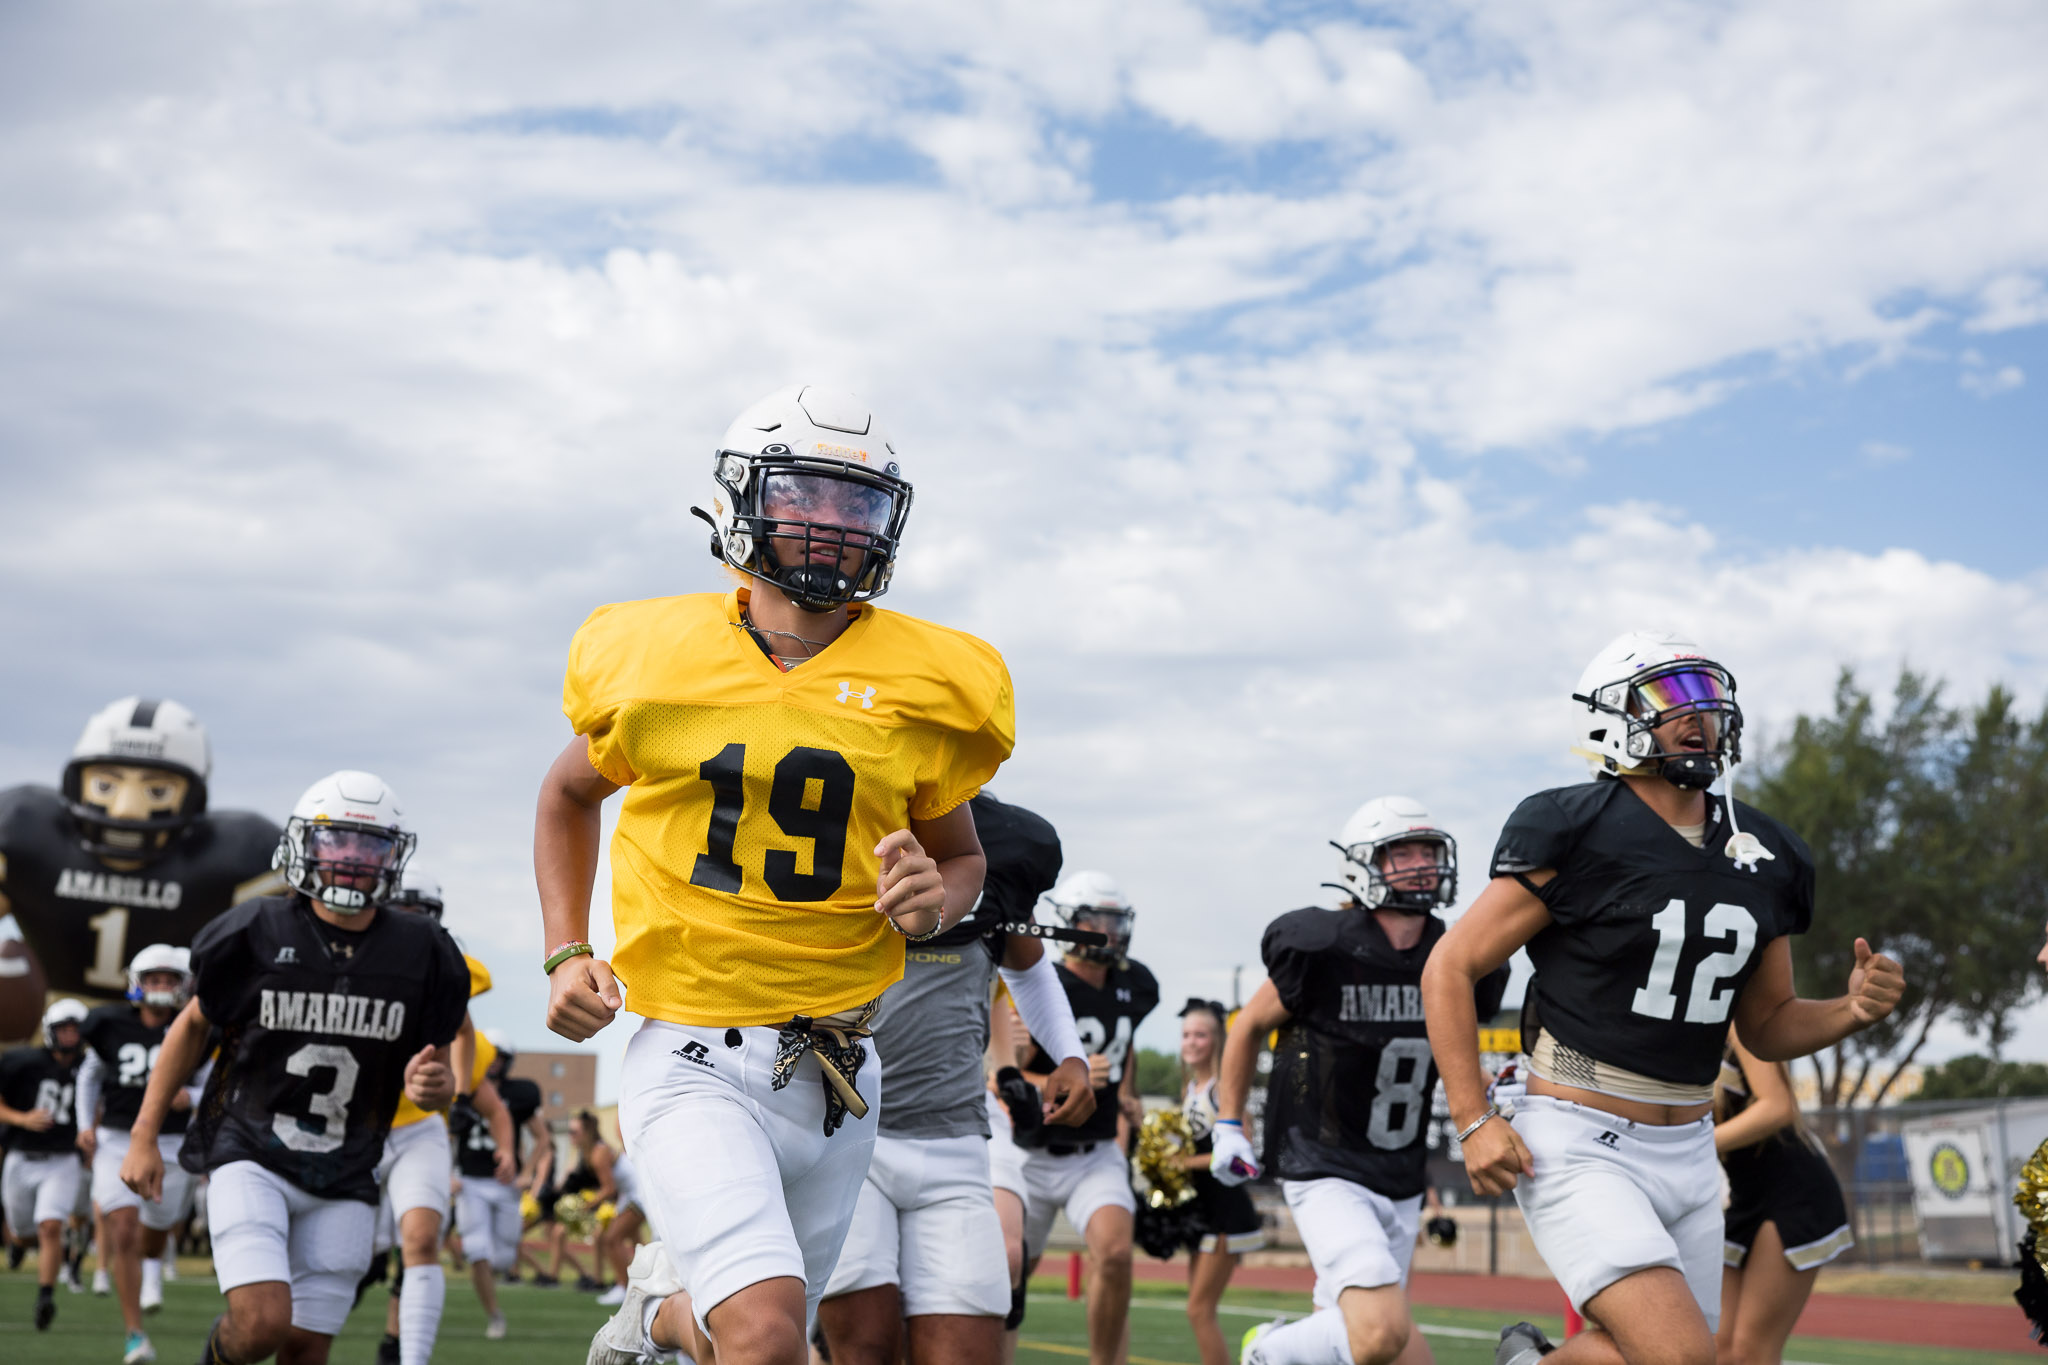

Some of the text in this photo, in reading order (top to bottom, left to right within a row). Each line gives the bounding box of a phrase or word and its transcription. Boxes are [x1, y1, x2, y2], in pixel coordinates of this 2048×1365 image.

[689, 743, 855, 901] 19
[54, 867, 182, 910] AMARILLO
[84, 907, 129, 990] 1
[1631, 899, 1758, 1024] 12
[259, 989, 406, 1042] AMARILLO
[271, 1043, 360, 1153] 3
[1366, 1037, 1432, 1150] 8
